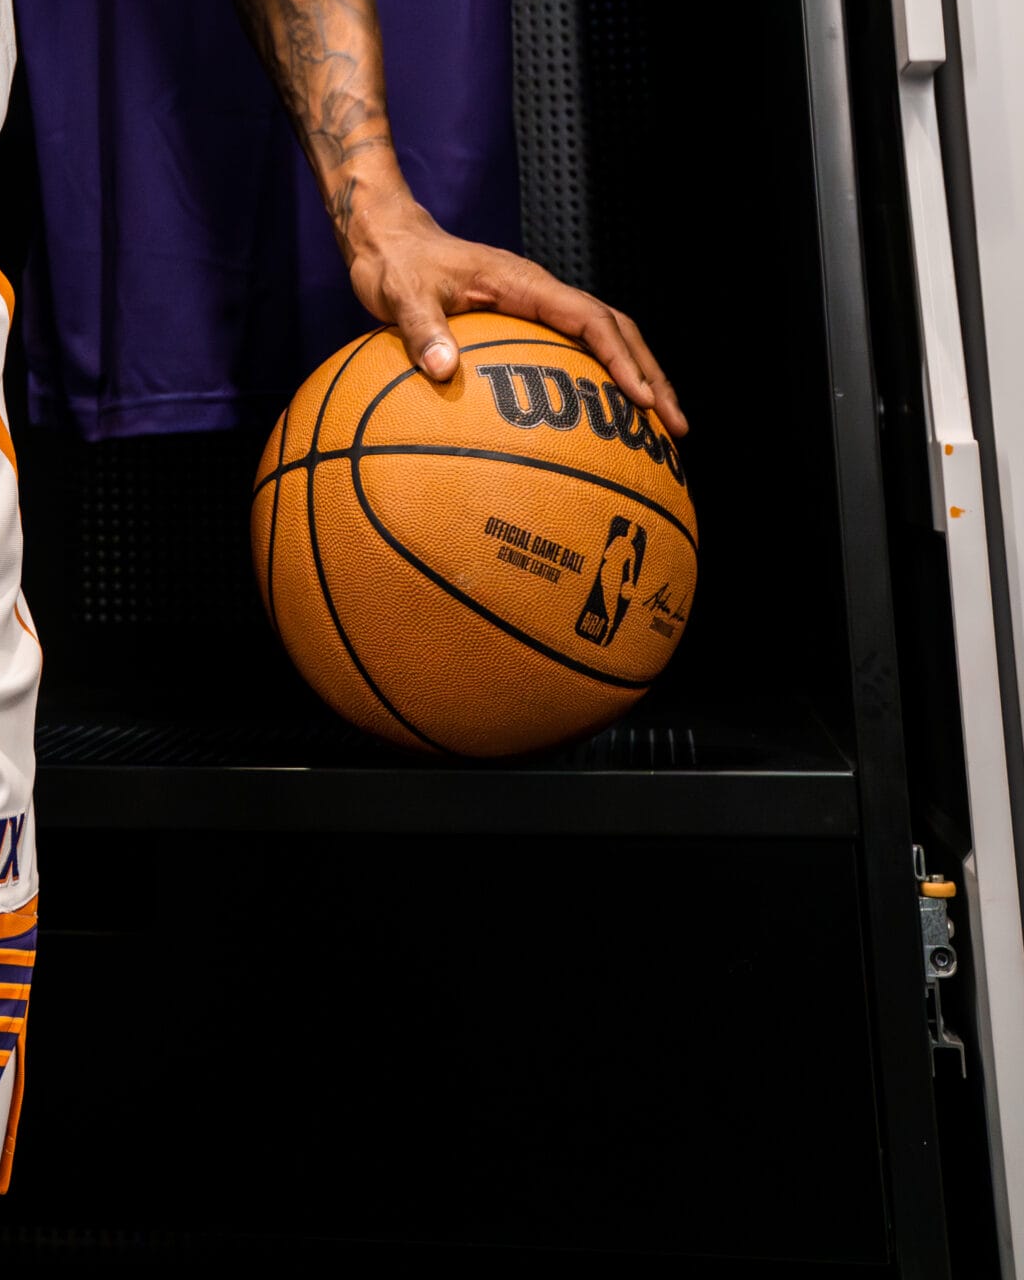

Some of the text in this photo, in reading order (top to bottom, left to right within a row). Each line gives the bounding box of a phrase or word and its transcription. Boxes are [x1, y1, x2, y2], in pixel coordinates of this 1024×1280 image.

[476, 363, 686, 487] Wilso
[484, 516, 586, 575] OFFICIAL GAME BALL
[497, 545, 562, 585] GENUINE LEATHER
[579, 611, 606, 638] NBA
